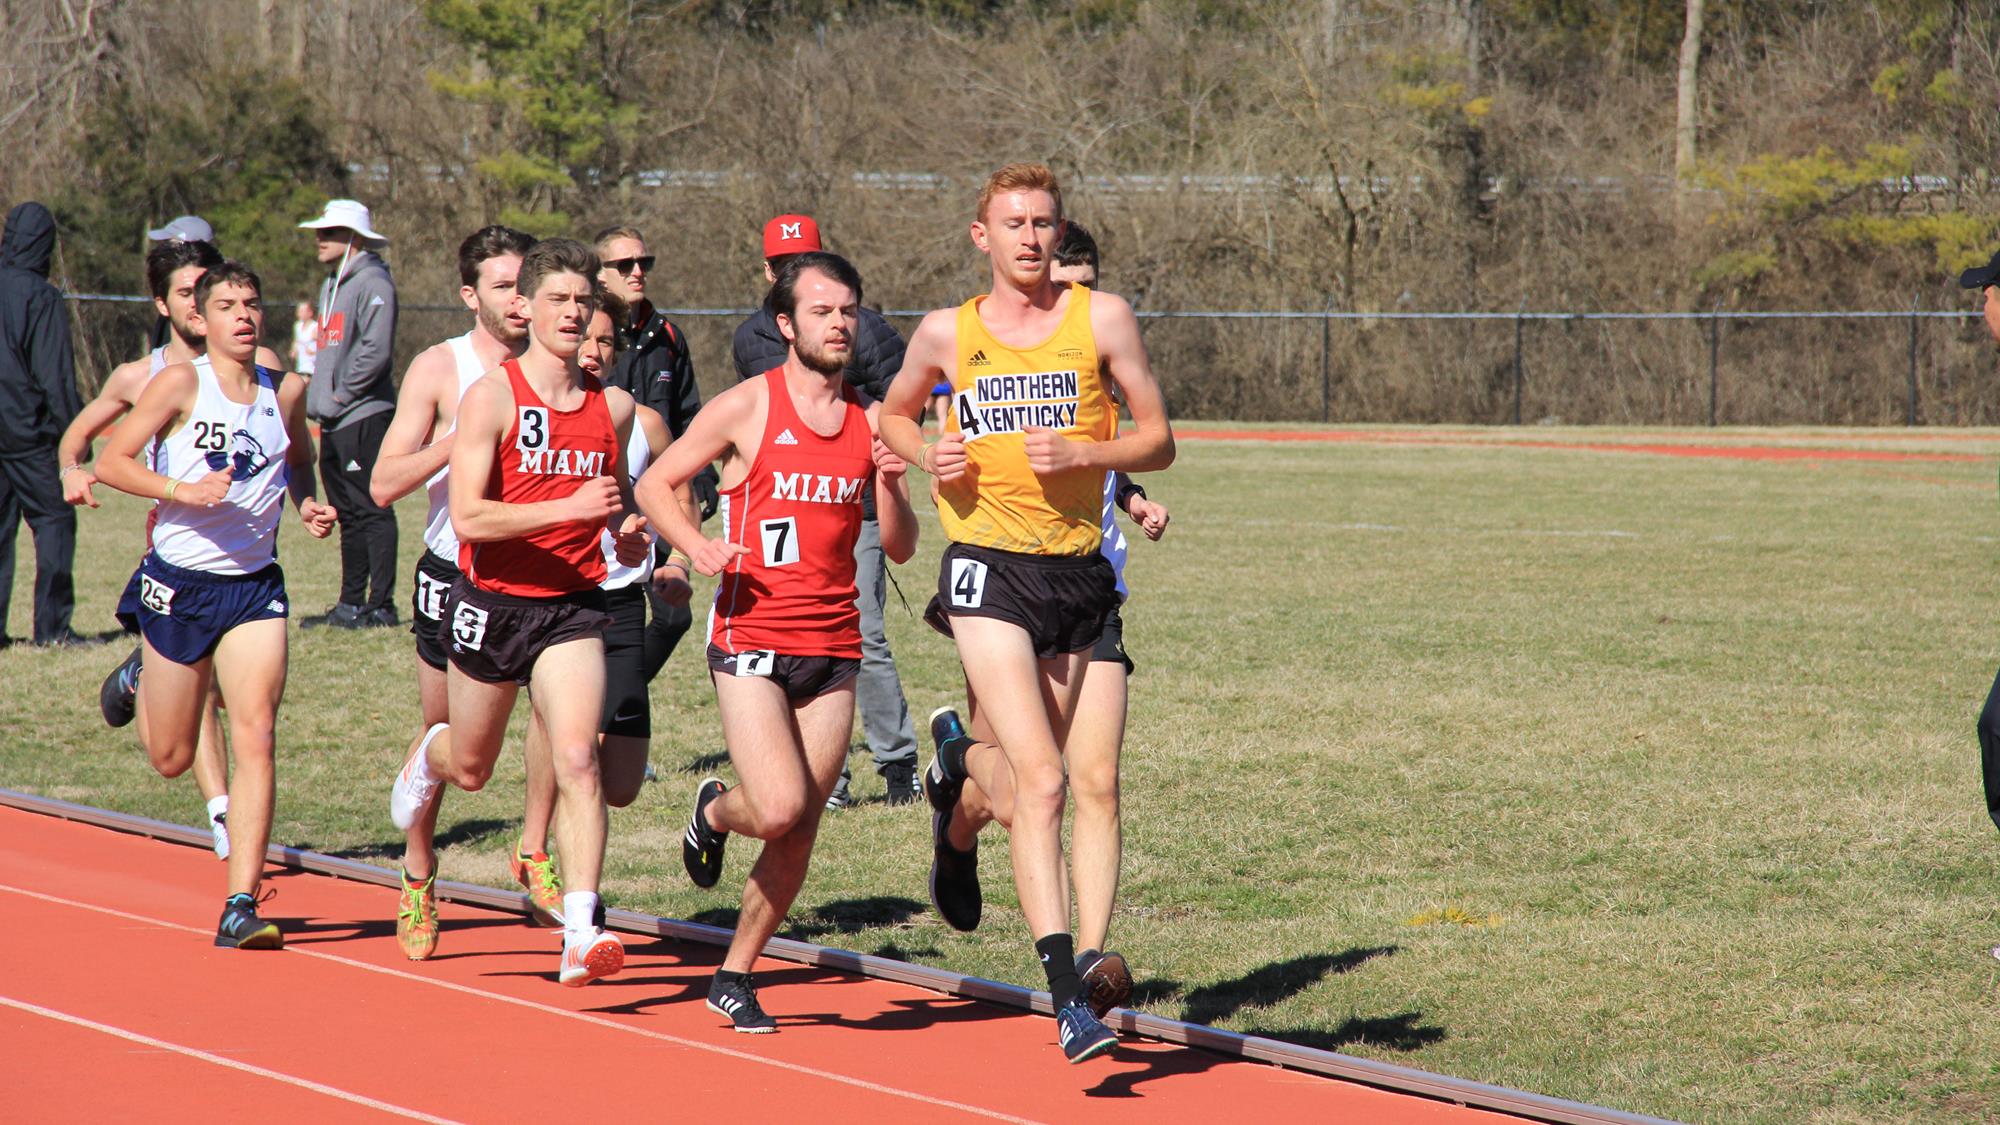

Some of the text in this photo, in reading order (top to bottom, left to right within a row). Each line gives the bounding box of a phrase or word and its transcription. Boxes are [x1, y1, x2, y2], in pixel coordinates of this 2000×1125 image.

[780, 222, 803, 241] M
[977, 372, 1077, 402] NORTHERN
[521, 409, 544, 448] 3
[960, 394, 980, 435] 4
[980, 403, 1077, 432] KENTUCKY
[194, 421, 226, 451] 25
[517, 449, 606, 478] MIAMI
[765, 521, 790, 562] 7
[143, 578, 168, 611] 25
[954, 562, 978, 604] 4
[455, 608, 480, 643] 3
[742, 650, 769, 675] 7
